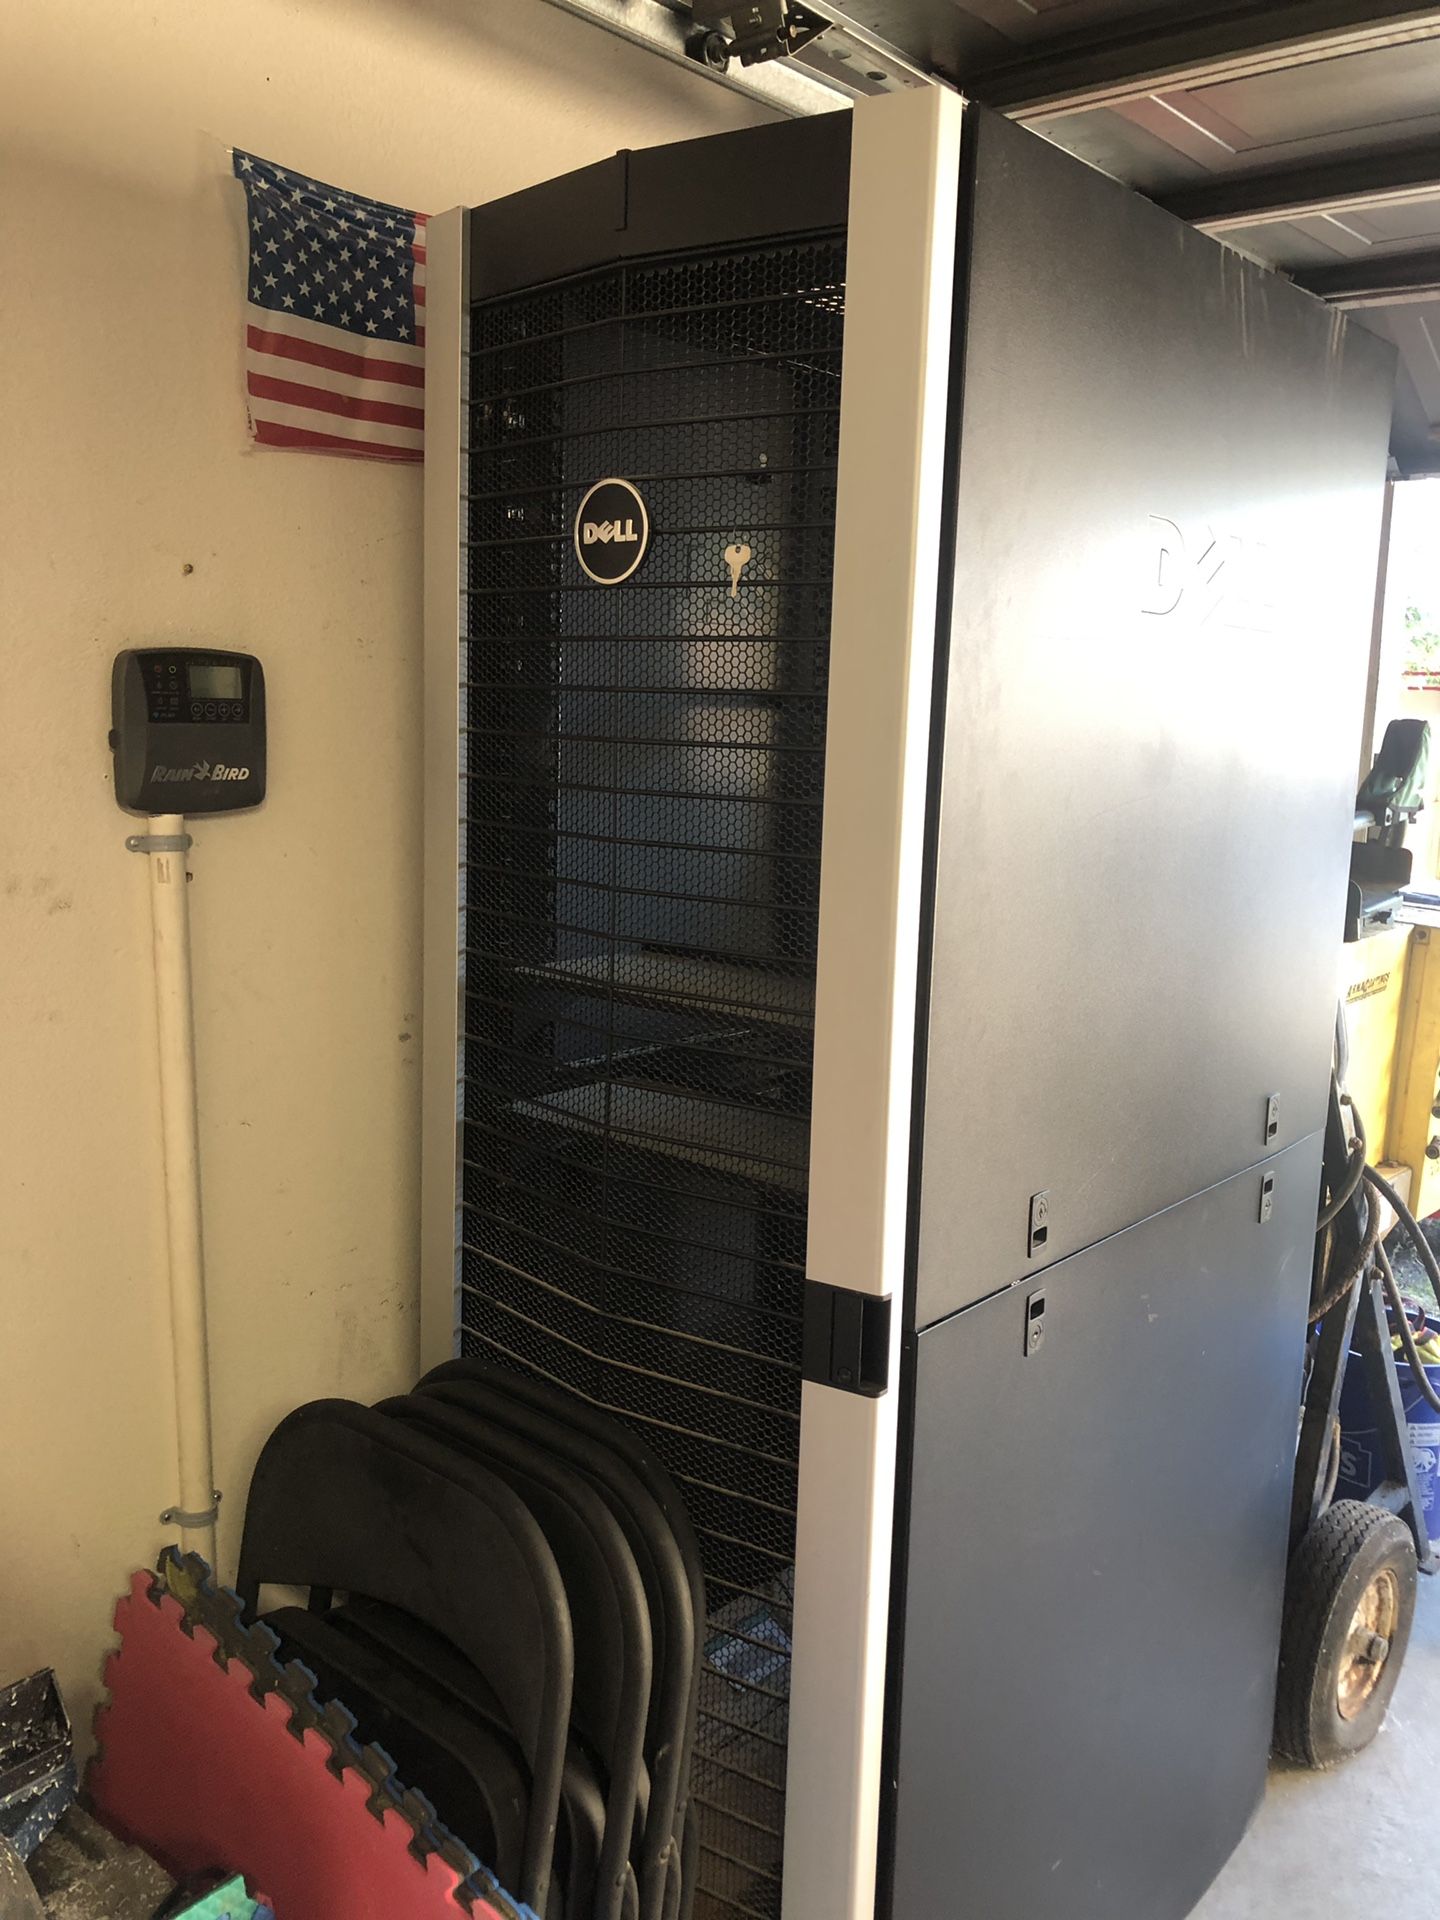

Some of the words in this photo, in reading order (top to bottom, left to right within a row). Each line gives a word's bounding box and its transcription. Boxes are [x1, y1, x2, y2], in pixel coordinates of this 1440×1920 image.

[583, 519, 638, 544] DELL
[151, 765, 194, 782] RAIN
[211, 764, 250, 781] BIRD
